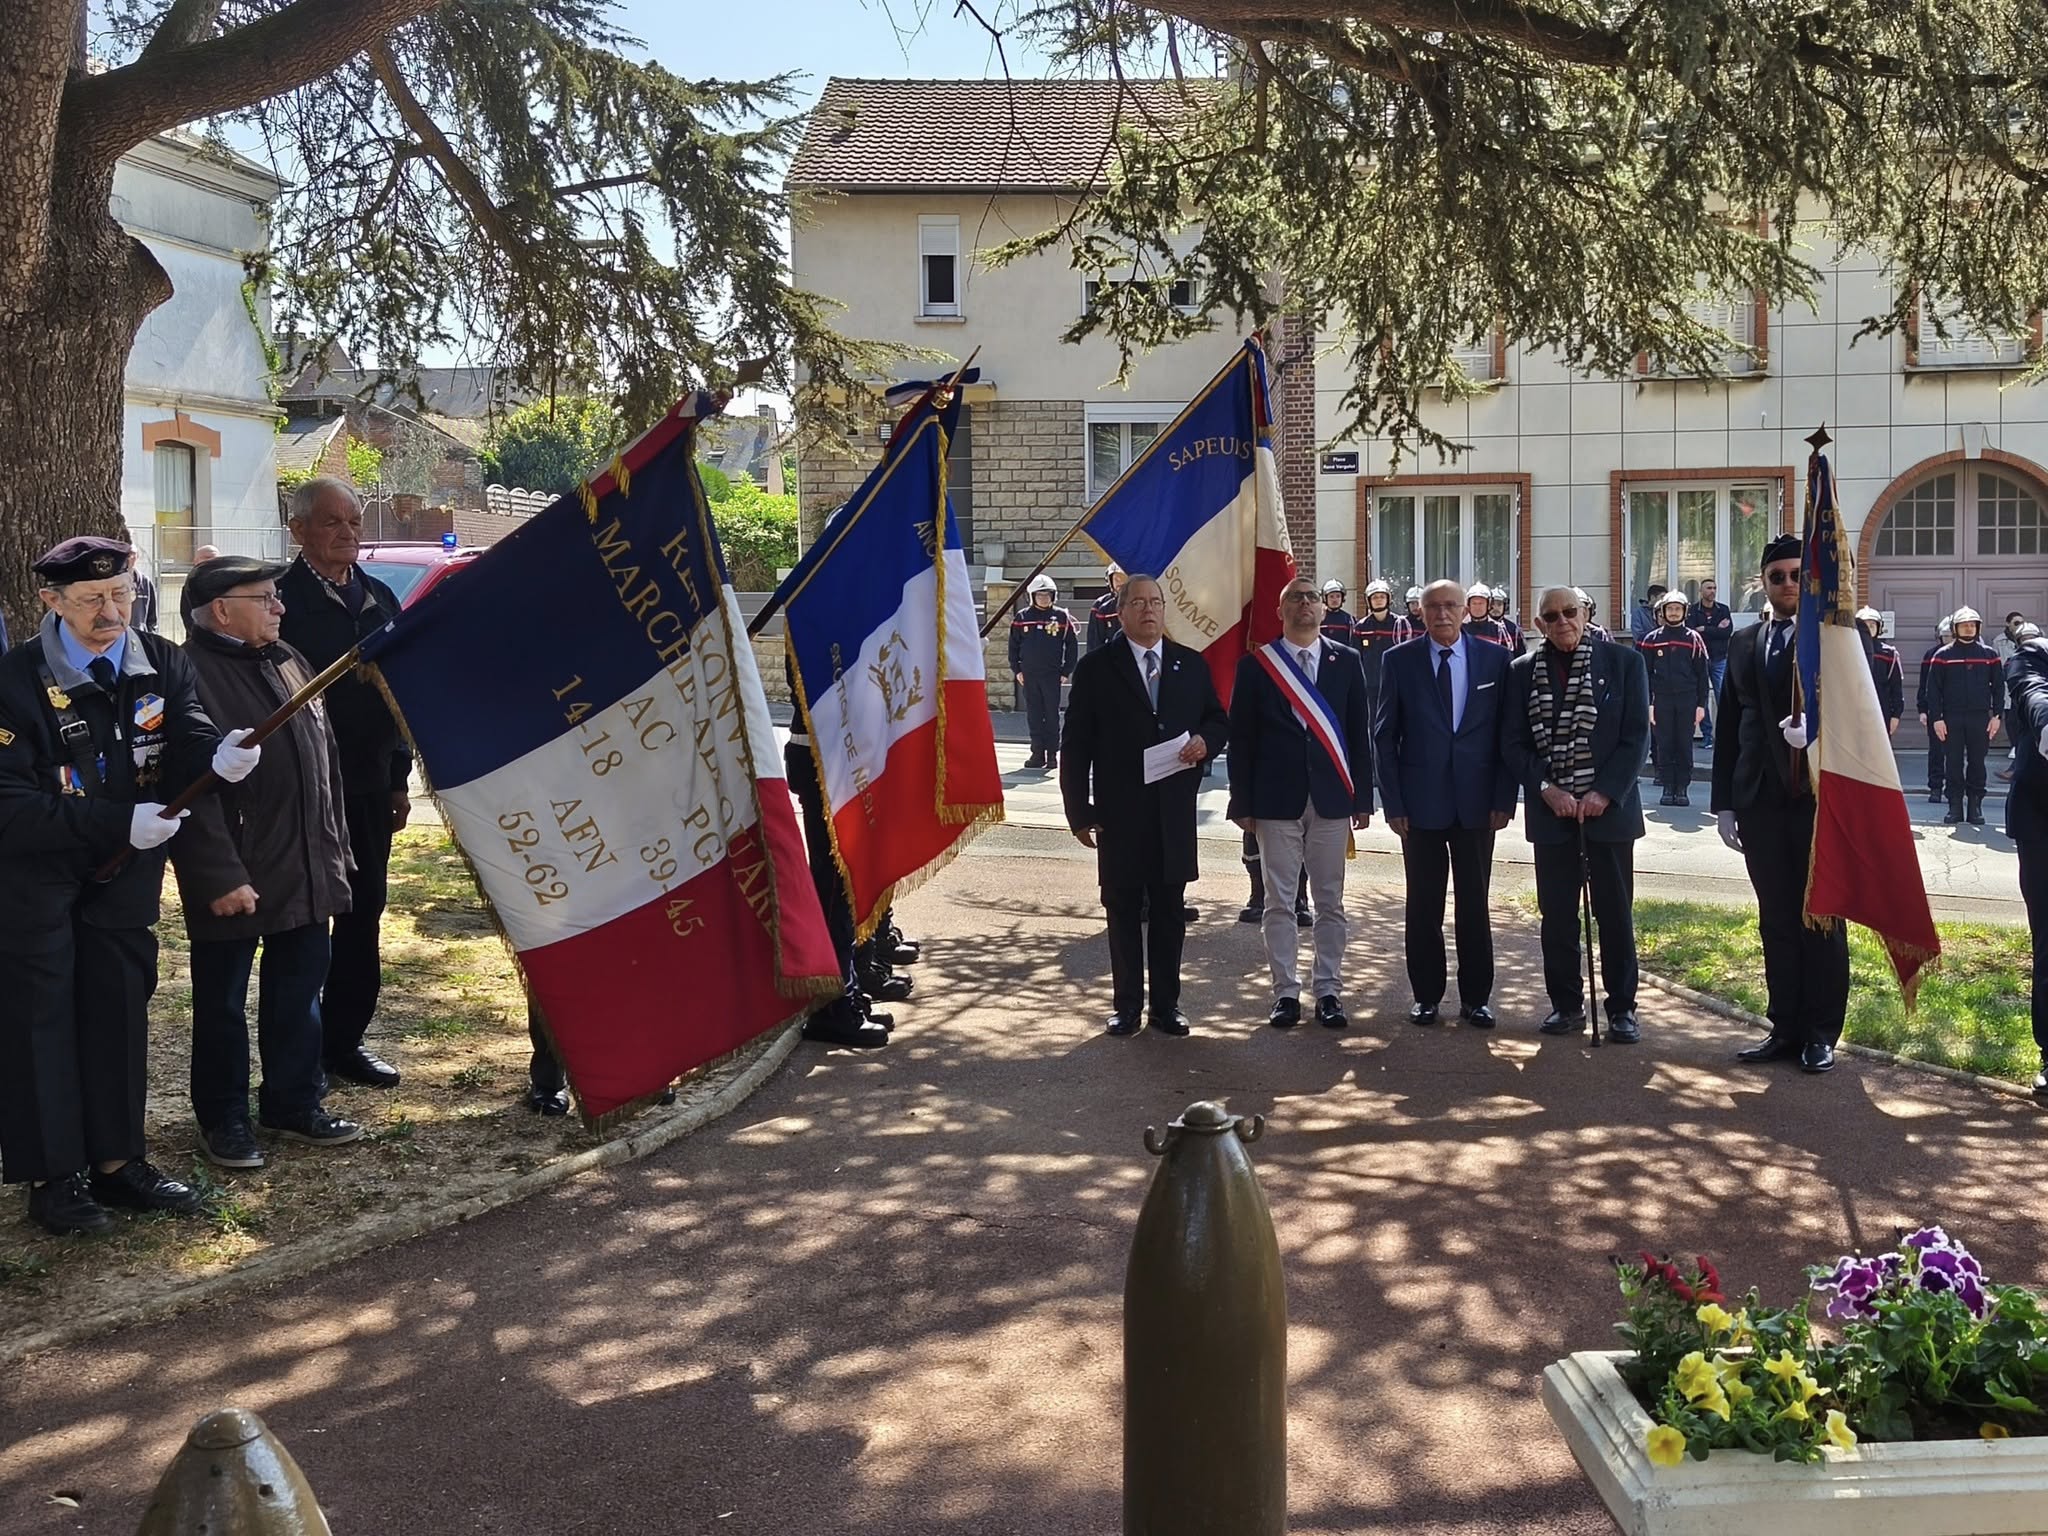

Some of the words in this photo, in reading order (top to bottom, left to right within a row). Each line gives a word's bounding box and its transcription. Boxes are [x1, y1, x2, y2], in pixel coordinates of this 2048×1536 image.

[1165, 566, 1219, 638] SOMME
[621, 693, 678, 753] AC
[681, 804, 723, 866] PG
[844, 732, 858, 762] DE
[549, 797, 618, 875] AFN
[552, 674, 624, 778] 14-18
[639, 837, 705, 937] 39-45
[497, 808, 569, 907] 52-62
